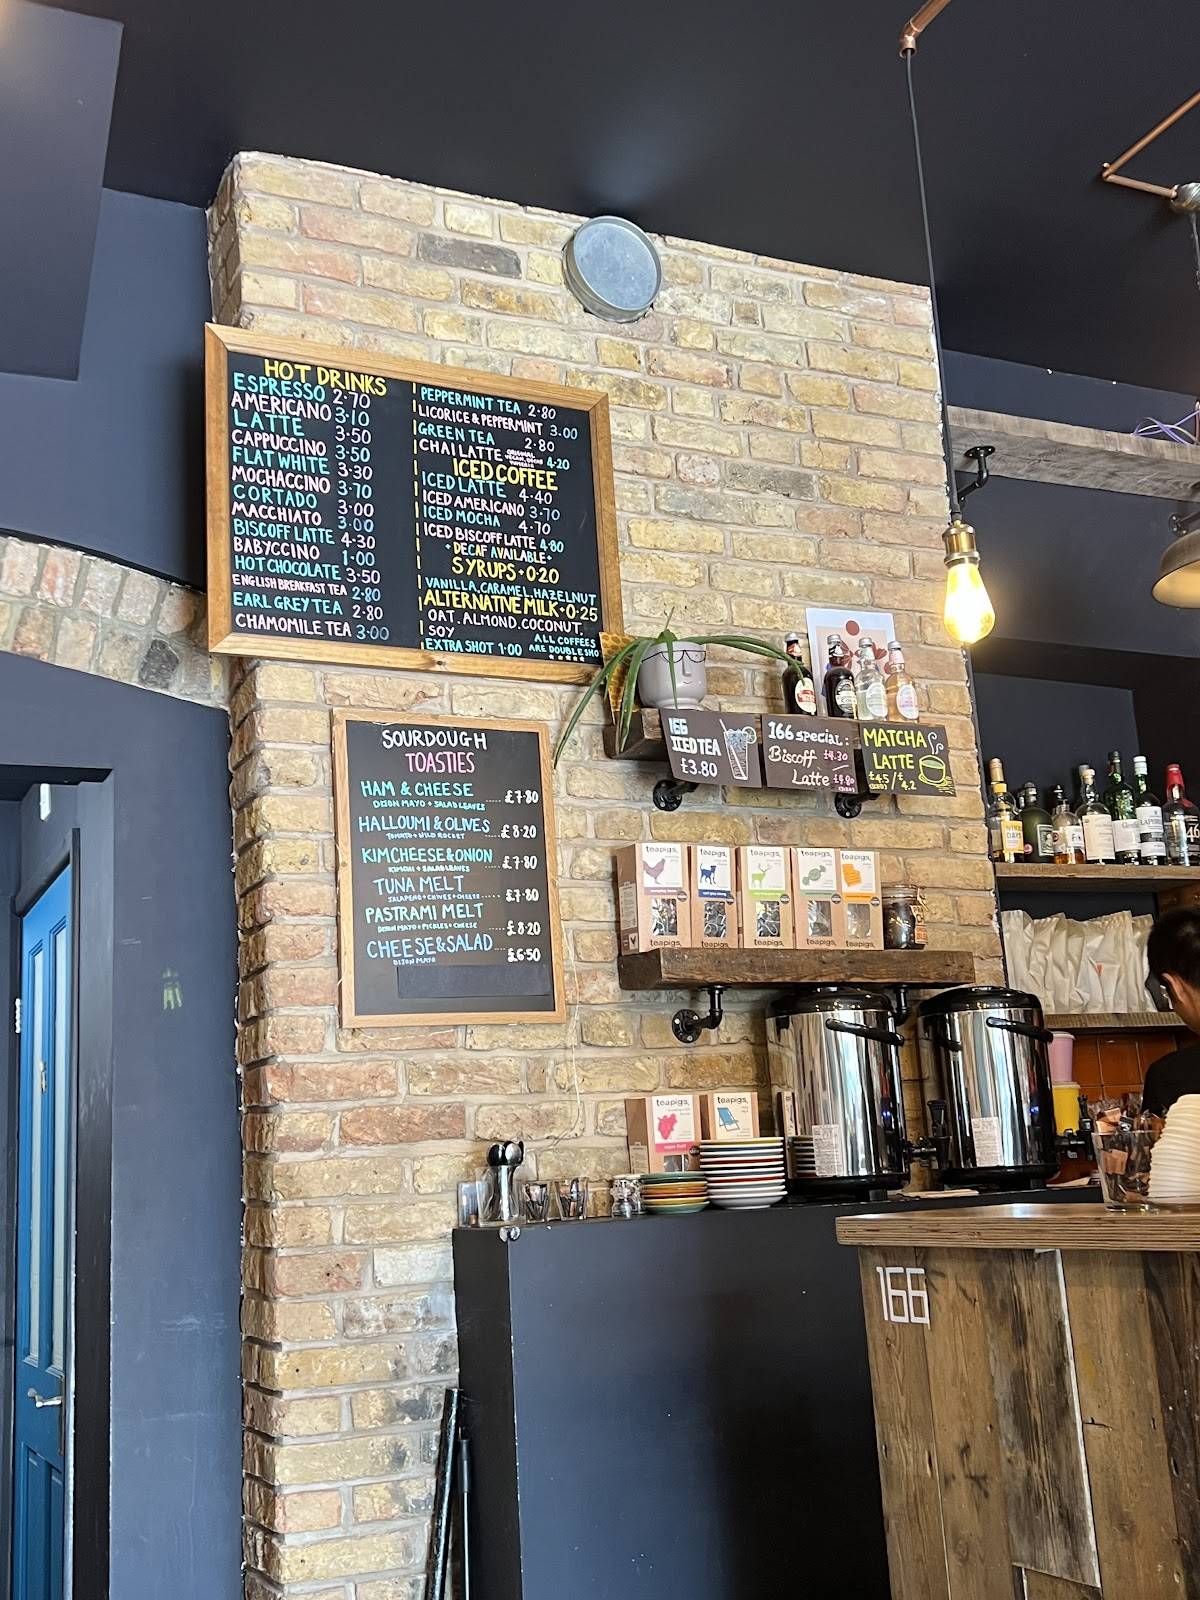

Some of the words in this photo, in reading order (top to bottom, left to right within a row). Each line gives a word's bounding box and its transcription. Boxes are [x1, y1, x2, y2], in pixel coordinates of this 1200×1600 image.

[233, 372, 325, 402] ESPRESSO
[264, 359, 311, 383] HOT
[317, 367, 387, 396] DRINKS
[231, 391, 331, 421] AMERICANO
[421, 386, 493, 410] PEPPERMINT
[497, 400, 521, 414] TEA
[234, 409, 304, 436] LATTE
[418, 404, 469, 424] LICORICE
[472, 415, 480, 425] &
[482, 414, 543, 435] PEPPERMINT
[232, 430, 326, 456] CAPPUCCINO
[418, 422, 465, 442] GREEN
[468, 430, 495, 445] TEA
[233, 446, 274, 467] FLAT
[278, 452, 330, 474] WHITE
[419, 439, 455, 456] CHAI
[459, 444, 503, 461] LATTE
[232, 465, 330, 494] MOCHACCINO
[422, 471, 455, 490] ICED
[458, 477, 506, 498] LATTE
[452, 458, 493, 481] ICED
[496, 464, 558, 491] COFFEE
[233, 484, 317, 508] CORTADO
[423, 490, 452, 506] ICED
[454, 496, 524, 516] AMERICANO
[232, 502, 321, 525] MACCHIATO
[423, 505, 452, 521] ICED
[456, 510, 500, 527] MOCHA
[233, 519, 290, 540] BISCOFF
[294, 526, 335, 544] LATTE
[424, 523, 453, 539] ICED
[455, 527, 502, 544] BISCOFF
[504, 534, 536, 550] LATTE
[234, 537, 320, 560] BABYCCINO
[453, 542, 488, 557] DECAF
[491, 546, 546, 564] AVAILABLE
[235, 555, 265, 572] HOT
[267, 558, 341, 580] CHOCOLATE
[452, 557, 516, 581] SYRUPS
[232, 574, 276, 589] ENGLISH
[278, 580, 326, 595] BREAKFAST
[328, 584, 347, 596] TEA
[233, 592, 272, 608] EARL
[274, 596, 310, 612] GREY
[311, 599, 343, 615] TEA
[424, 589, 522, 614] ALTERNATIVE
[523, 597, 559, 618] MILK
[533, 589, 596, 606] HAZELNUT
[235, 614, 323, 635] CHAMOMILE
[325, 620, 352, 636] TEA
[428, 625, 454, 638] SOY
[425, 638, 464, 652] EXTRA
[465, 640, 494, 654] SHOT
[529, 644, 546, 653] ARE
[549, 645, 583, 655] DOUBLE
[584, 649, 600, 658] SHO
[534, 633, 555, 644] ALL
[557, 636, 596, 648] COFFEES
[382, 729, 487, 750] SOURDOUGH
[768, 721, 793, 741] 166
[863, 728, 927, 748] MATCHA
[671, 736, 697, 754] ICED
[698, 739, 721, 756] TEA
[768, 745, 817, 767] Biscoff
[405, 751, 476, 774] TOASTIES
[681, 758, 718, 777] £3.80
[873, 753, 914, 770] LATTE
[792, 769, 830, 786] Latte
[361, 781, 395, 798] HAM
[400, 782, 411, 796] &
[414, 782, 473, 797] CHEESE
[402, 800, 425, 808] MAYO
[359, 816, 430, 832] HALLOUMI
[434, 816, 443, 831] &
[445, 816, 490, 833] OLIVES
[373, 877, 415, 895] TUNA
[420, 875, 464, 893] MELT
[365, 905, 436, 923] PASTRAMI
[442, 903, 483, 918] MELT
[876, 1267, 930, 1330] 166
